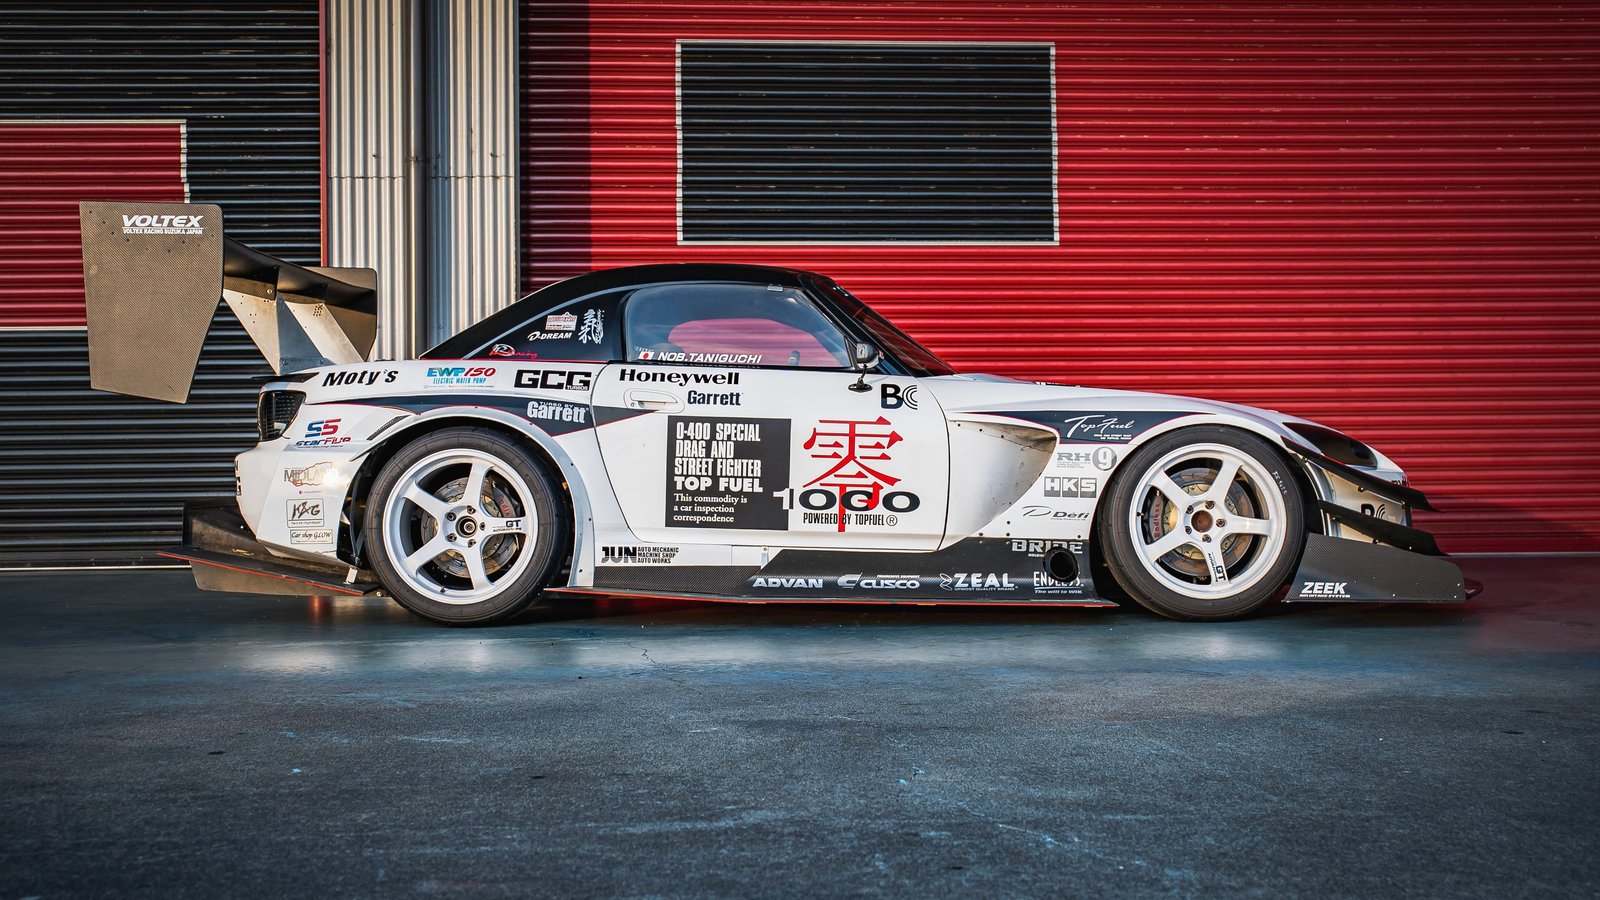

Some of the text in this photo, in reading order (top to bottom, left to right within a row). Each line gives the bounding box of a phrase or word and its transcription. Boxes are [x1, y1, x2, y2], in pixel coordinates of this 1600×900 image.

[122, 215, 204, 227] VOLTEX
[322, 369, 399, 387] Moty's
[514, 370, 592, 391] GCG
[619, 369, 740, 387] Honeywell
[687, 390, 741, 406] Garrett
[527, 401, 586, 423] Garrett
[716, 423, 761, 441] SPECIAL
[675, 440, 735, 458] DRAG AND
[674, 458, 762, 477] STREET FIGHTER
[674, 476, 764, 493] TOP FUEL
[1044, 476, 1097, 498] HKS
[674, 493, 748, 505] This commodity is
[694, 504, 735, 514] inspection
[506, 519, 522, 528] GT
[673, 514, 735, 524] correspondence
[803, 512, 838, 525] POWERED
[842, 513, 852, 525] BY
[601, 546, 637, 563] JUN
[752, 577, 824, 589] ADVAN
[954, 573, 1015, 587] ZEAL
[1301, 582, 1348, 594] ZEEK
